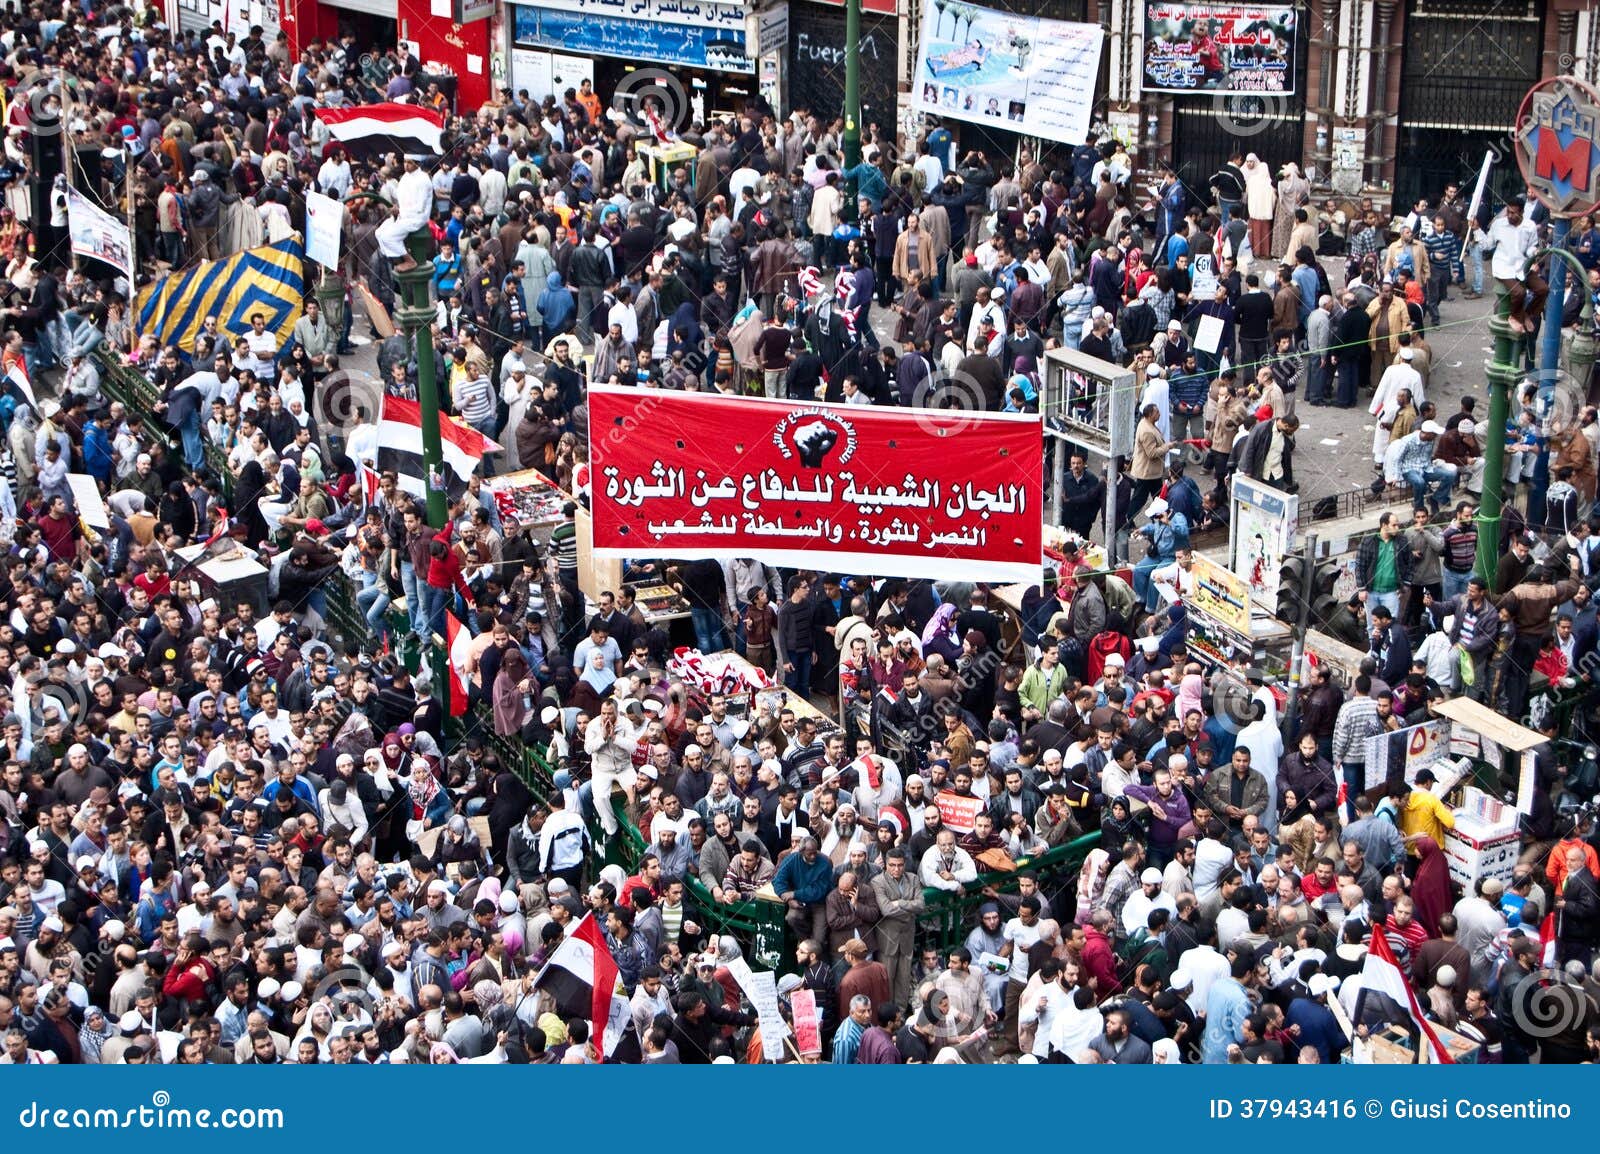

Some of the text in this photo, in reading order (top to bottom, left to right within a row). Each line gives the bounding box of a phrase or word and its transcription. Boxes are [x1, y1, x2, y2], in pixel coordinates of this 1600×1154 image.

[656, 0, 699, 20] مباشر
[706, 5, 744, 24] طيران
[1536, 127, 1591, 191] M
[602, 460, 1026, 522] اللجان الشعبية للدفاع عن الثورة
[647, 511, 738, 545] للشعب
[743, 512, 843, 541] والسلطة
[924, 520, 987, 549] النصر
